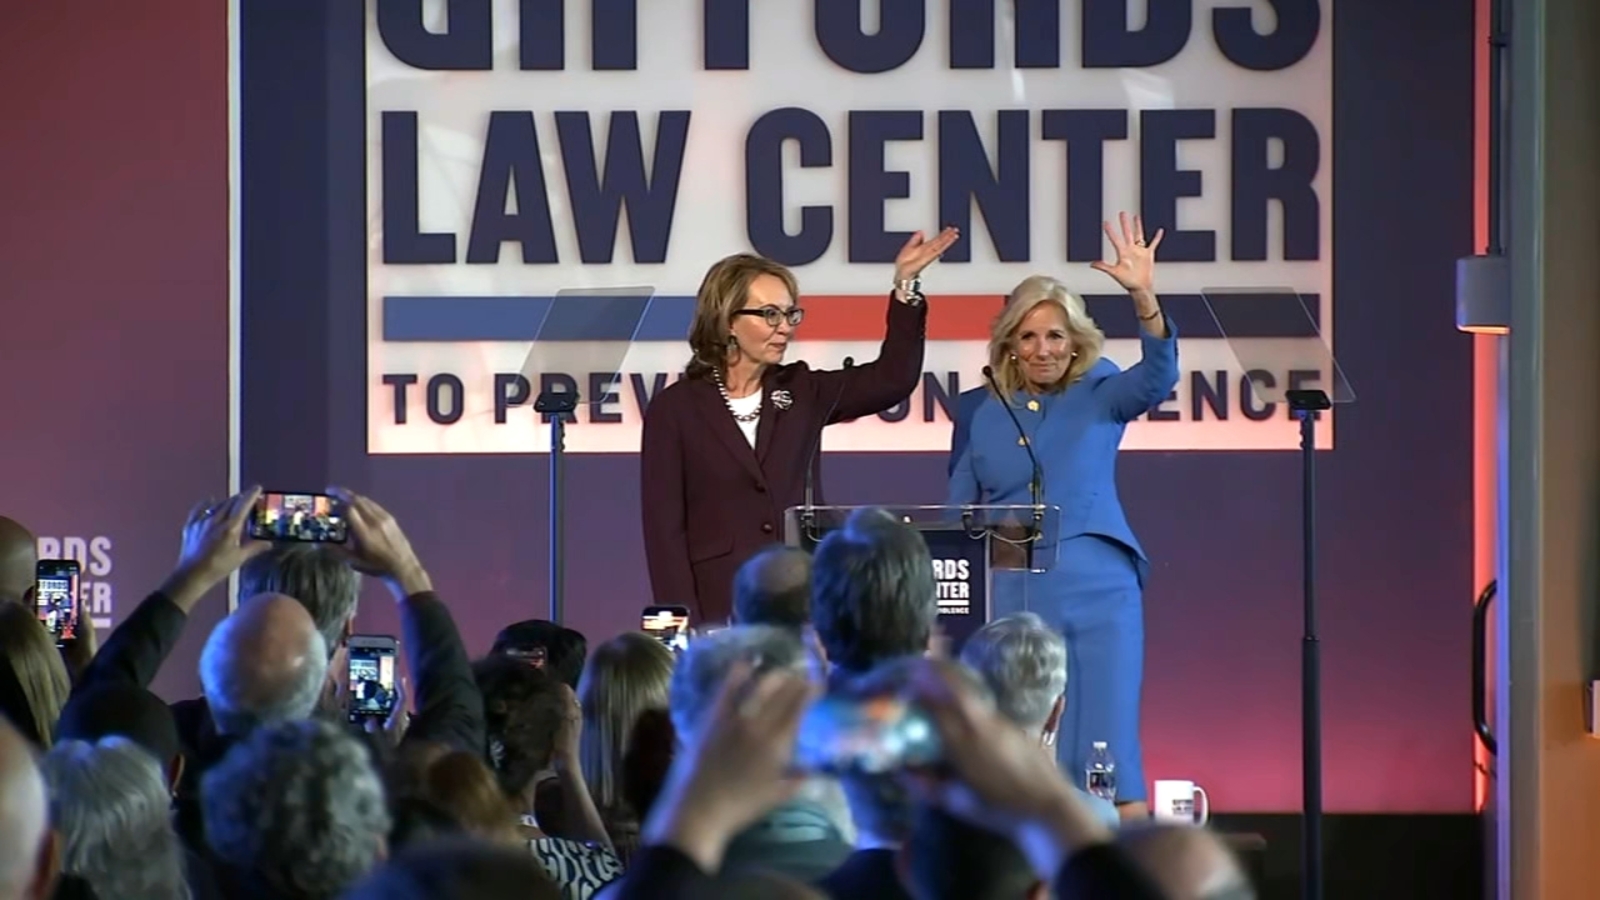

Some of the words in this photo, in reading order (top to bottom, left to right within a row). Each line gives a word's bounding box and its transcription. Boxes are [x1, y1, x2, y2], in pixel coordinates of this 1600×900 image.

[382, 110, 691, 264] LAW
[745, 107, 1320, 265] CENTER
[382, 373, 464, 425] TO
[494, 373, 669, 425] PREV
[932, 559, 969, 580] RDS
